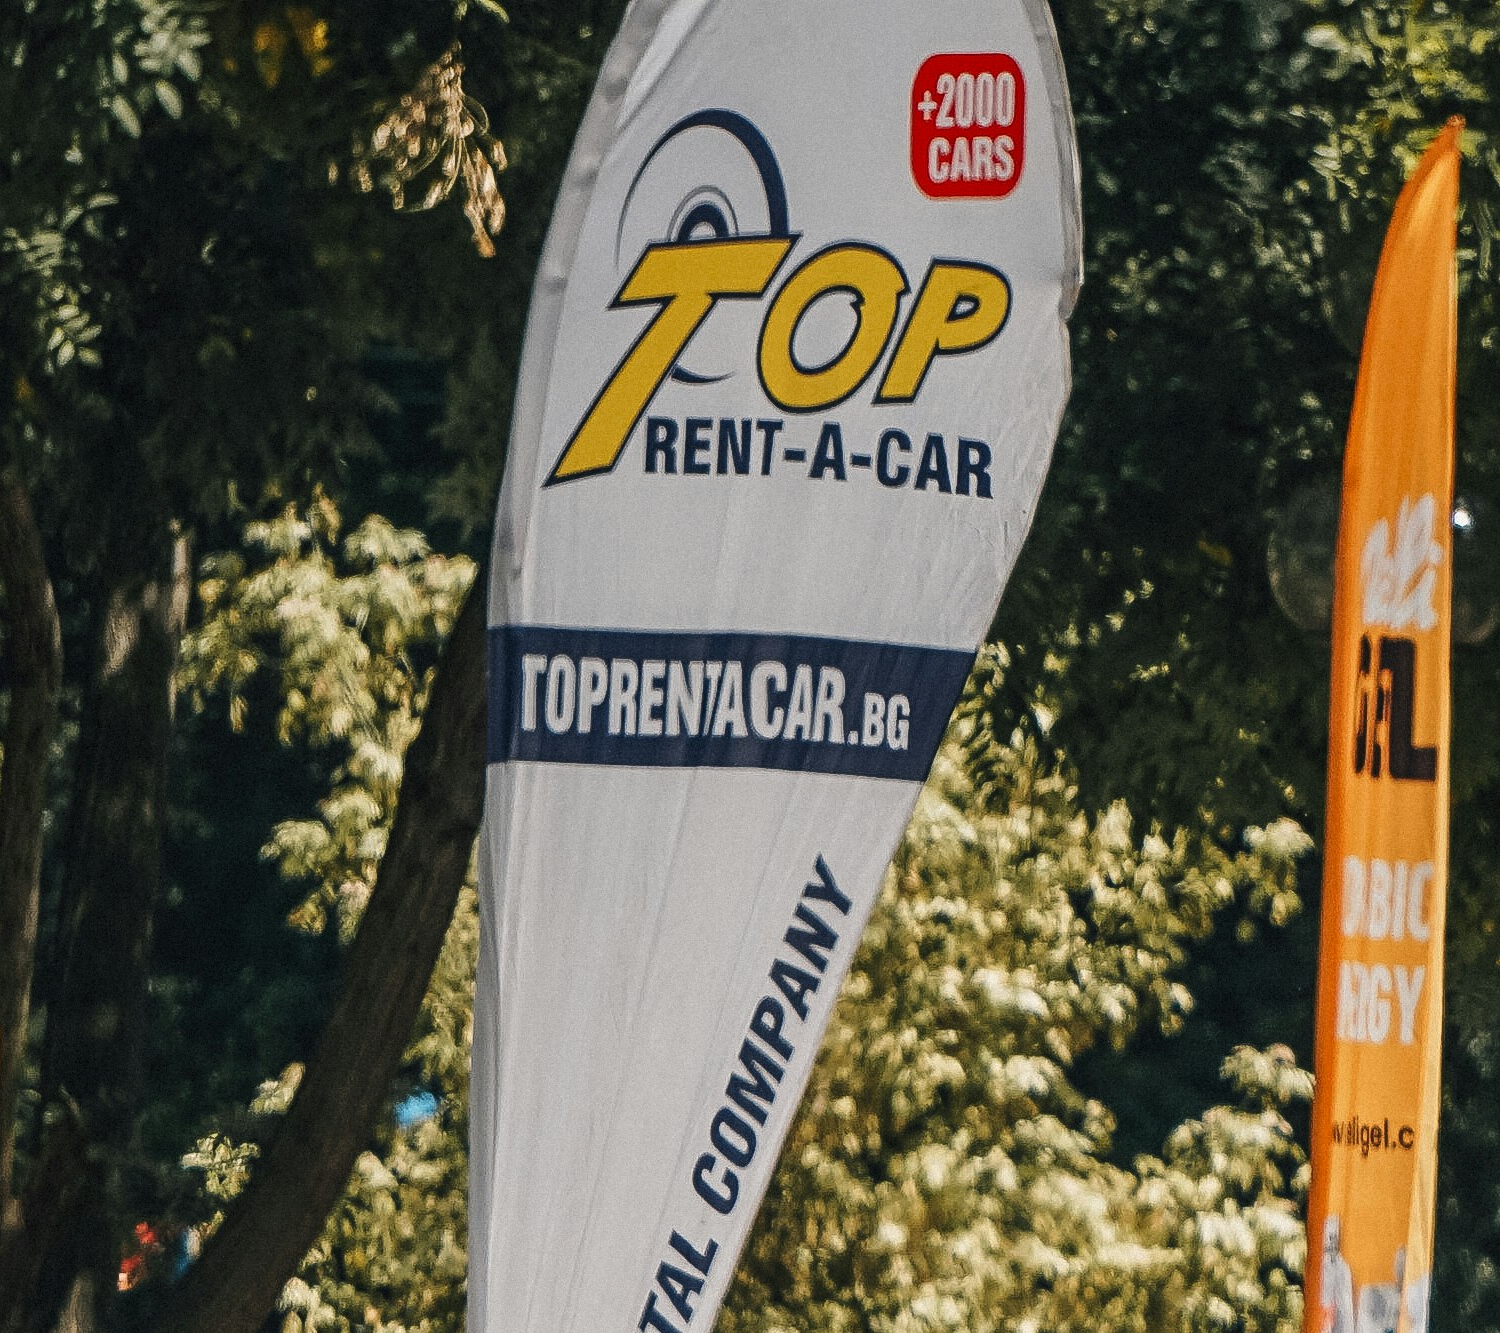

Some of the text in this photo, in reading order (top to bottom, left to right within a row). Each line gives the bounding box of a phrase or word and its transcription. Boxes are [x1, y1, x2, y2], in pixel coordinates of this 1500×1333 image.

[917, 72, 1016, 130] +2000
[927, 135, 1016, 184] CARS
[542, 232, 1014, 488] TOP
[643, 415, 994, 500] RENT-A-CAR
[520, 653, 911, 751] TOPRENTACAR.BG
[690, 852, 857, 1217] COMPANY
